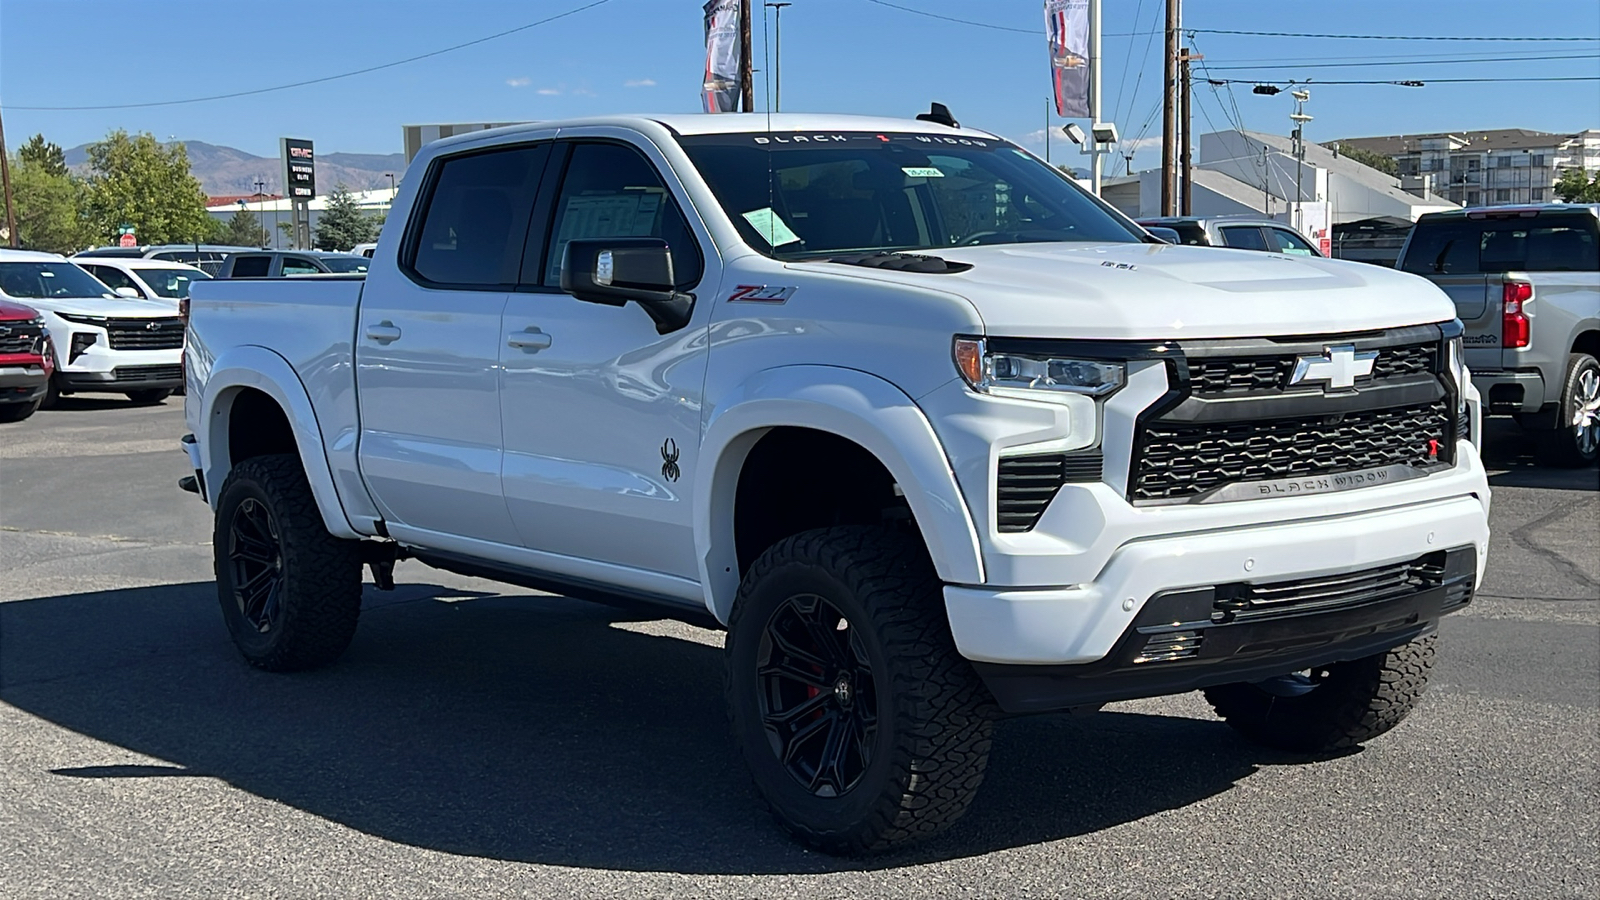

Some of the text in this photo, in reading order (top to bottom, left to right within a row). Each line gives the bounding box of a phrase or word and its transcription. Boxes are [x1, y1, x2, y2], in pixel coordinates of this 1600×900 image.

[754, 135, 987, 147] BLACK WIDOW
[290, 147, 313, 158] GMC
[727, 284, 788, 304] Z71
[1257, 470, 1388, 494] BLACK WIDOW
